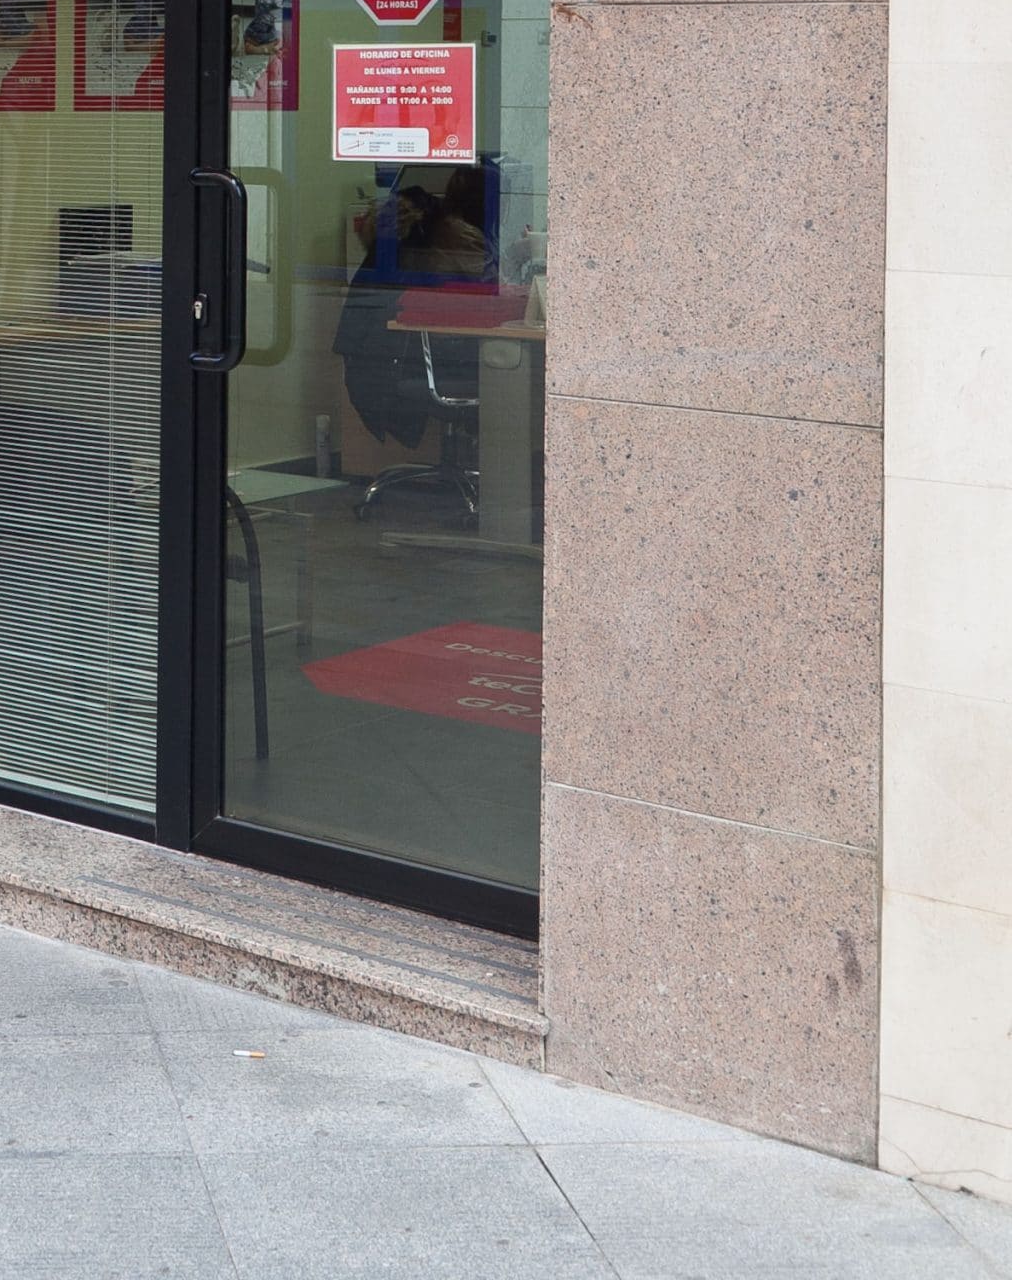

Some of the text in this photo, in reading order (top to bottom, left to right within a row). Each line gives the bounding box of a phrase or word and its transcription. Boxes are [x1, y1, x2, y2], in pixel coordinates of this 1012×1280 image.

[360, 49, 450, 59] HORARIO DE OFICINA
[364, 67, 375, 75] DE
[376, 67, 402, 75] LUNES
[411, 66, 446, 74] VIERNES
[346, 85, 385, 94] MAÑANAS
[400, 86, 417, 94] 9:00
[431, 148, 472, 158] MAPFRE
